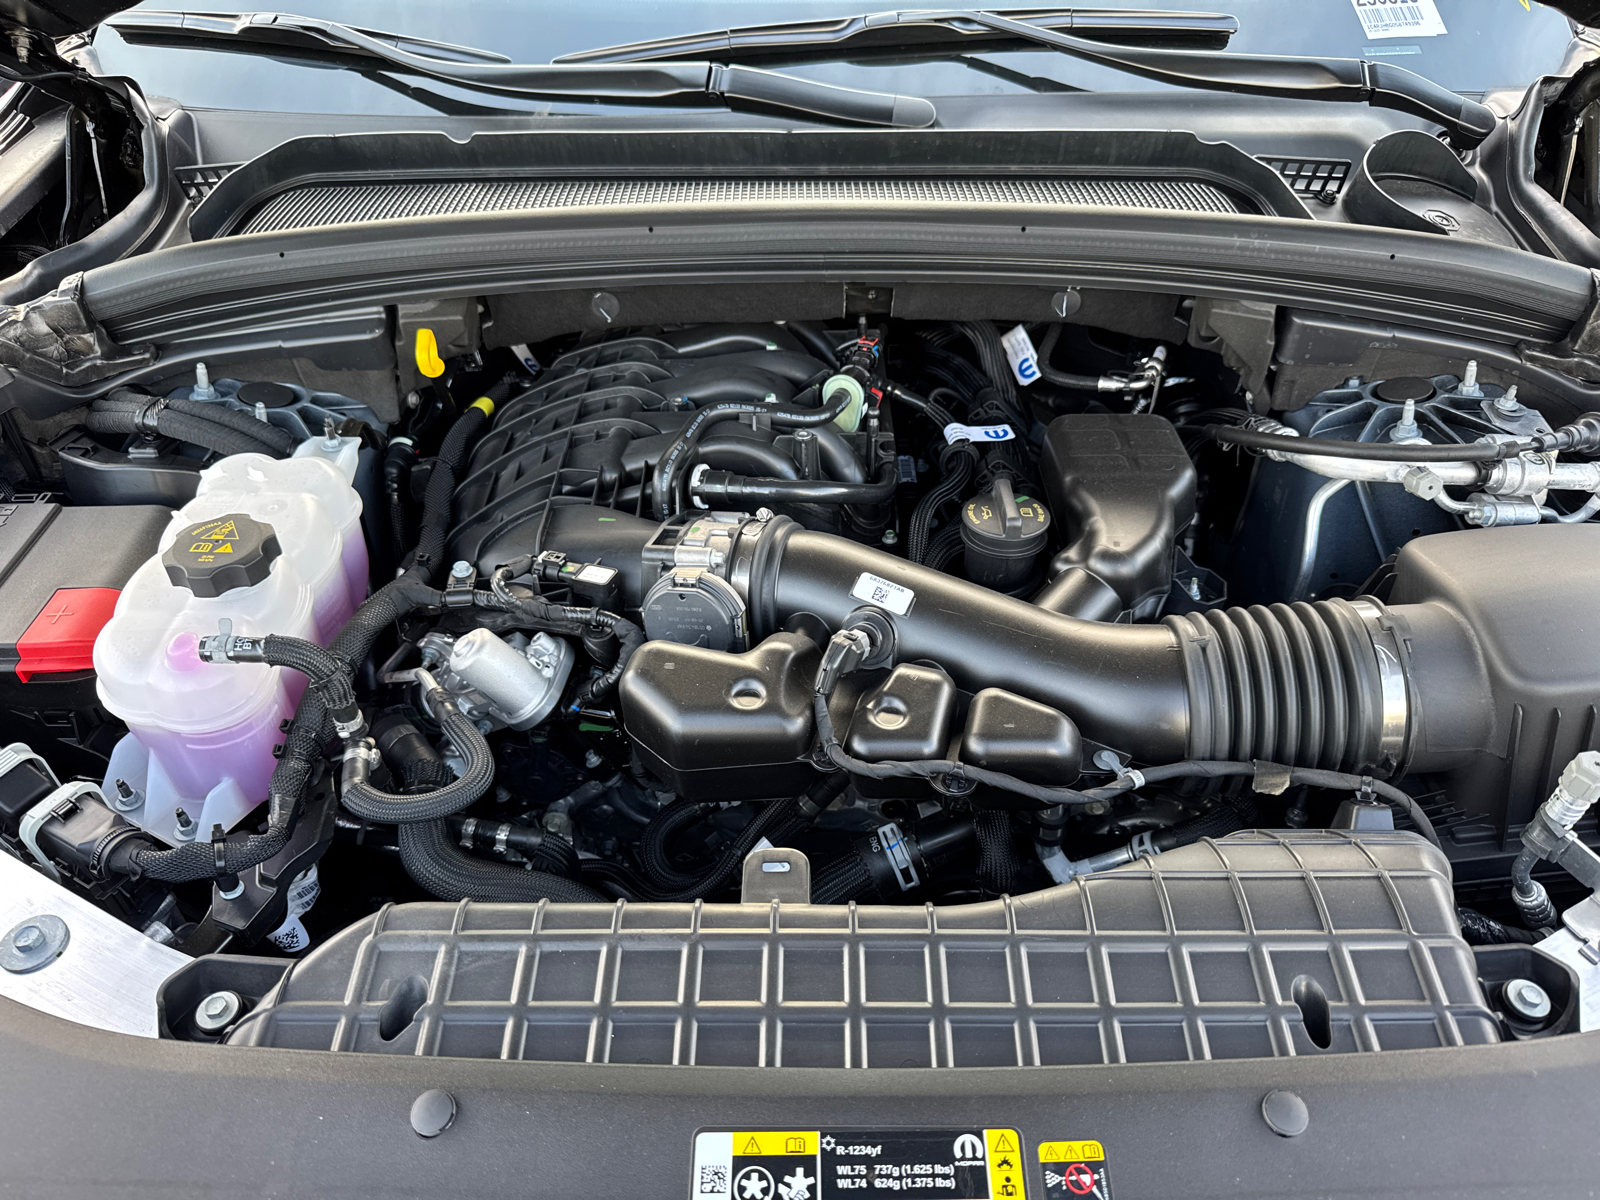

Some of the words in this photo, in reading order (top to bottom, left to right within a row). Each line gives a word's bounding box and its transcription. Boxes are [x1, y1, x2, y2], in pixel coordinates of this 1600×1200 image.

[869, 836, 881, 853] ENG
[836, 1145, 882, 1157] R-1234yf
[836, 1165, 867, 1175] WL75
[874, 1165, 900, 1177] 737g
[901, 1164, 933, 1177] (1.625
[934, 1164, 955, 1176] lbs)
[836, 1178, 867, 1189] WL74
[874, 1178, 900, 1190] 624g
[901, 1177, 934, 1190] (1.375
[935, 1177, 956, 1190] lbs)
